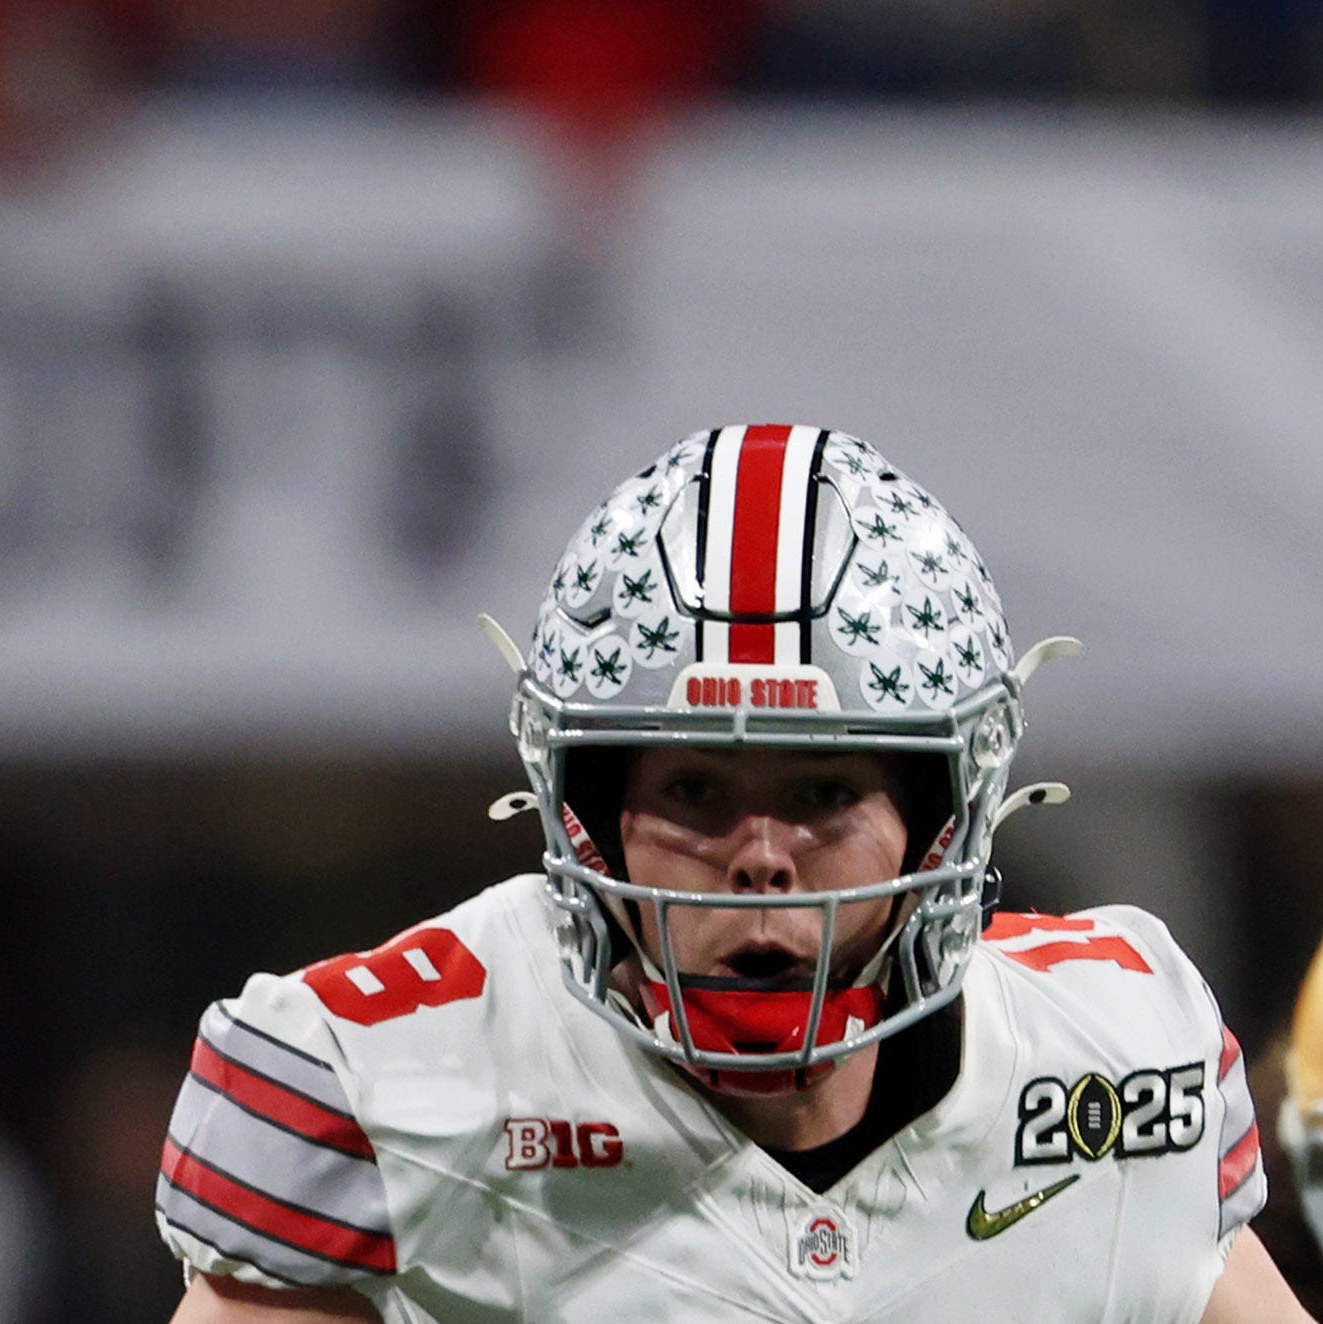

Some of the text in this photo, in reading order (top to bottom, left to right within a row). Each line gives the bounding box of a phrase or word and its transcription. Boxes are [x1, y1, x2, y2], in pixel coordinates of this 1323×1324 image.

[687, 677, 818, 709] OHIO STATE
[1014, 1061, 1206, 1168] 2025
